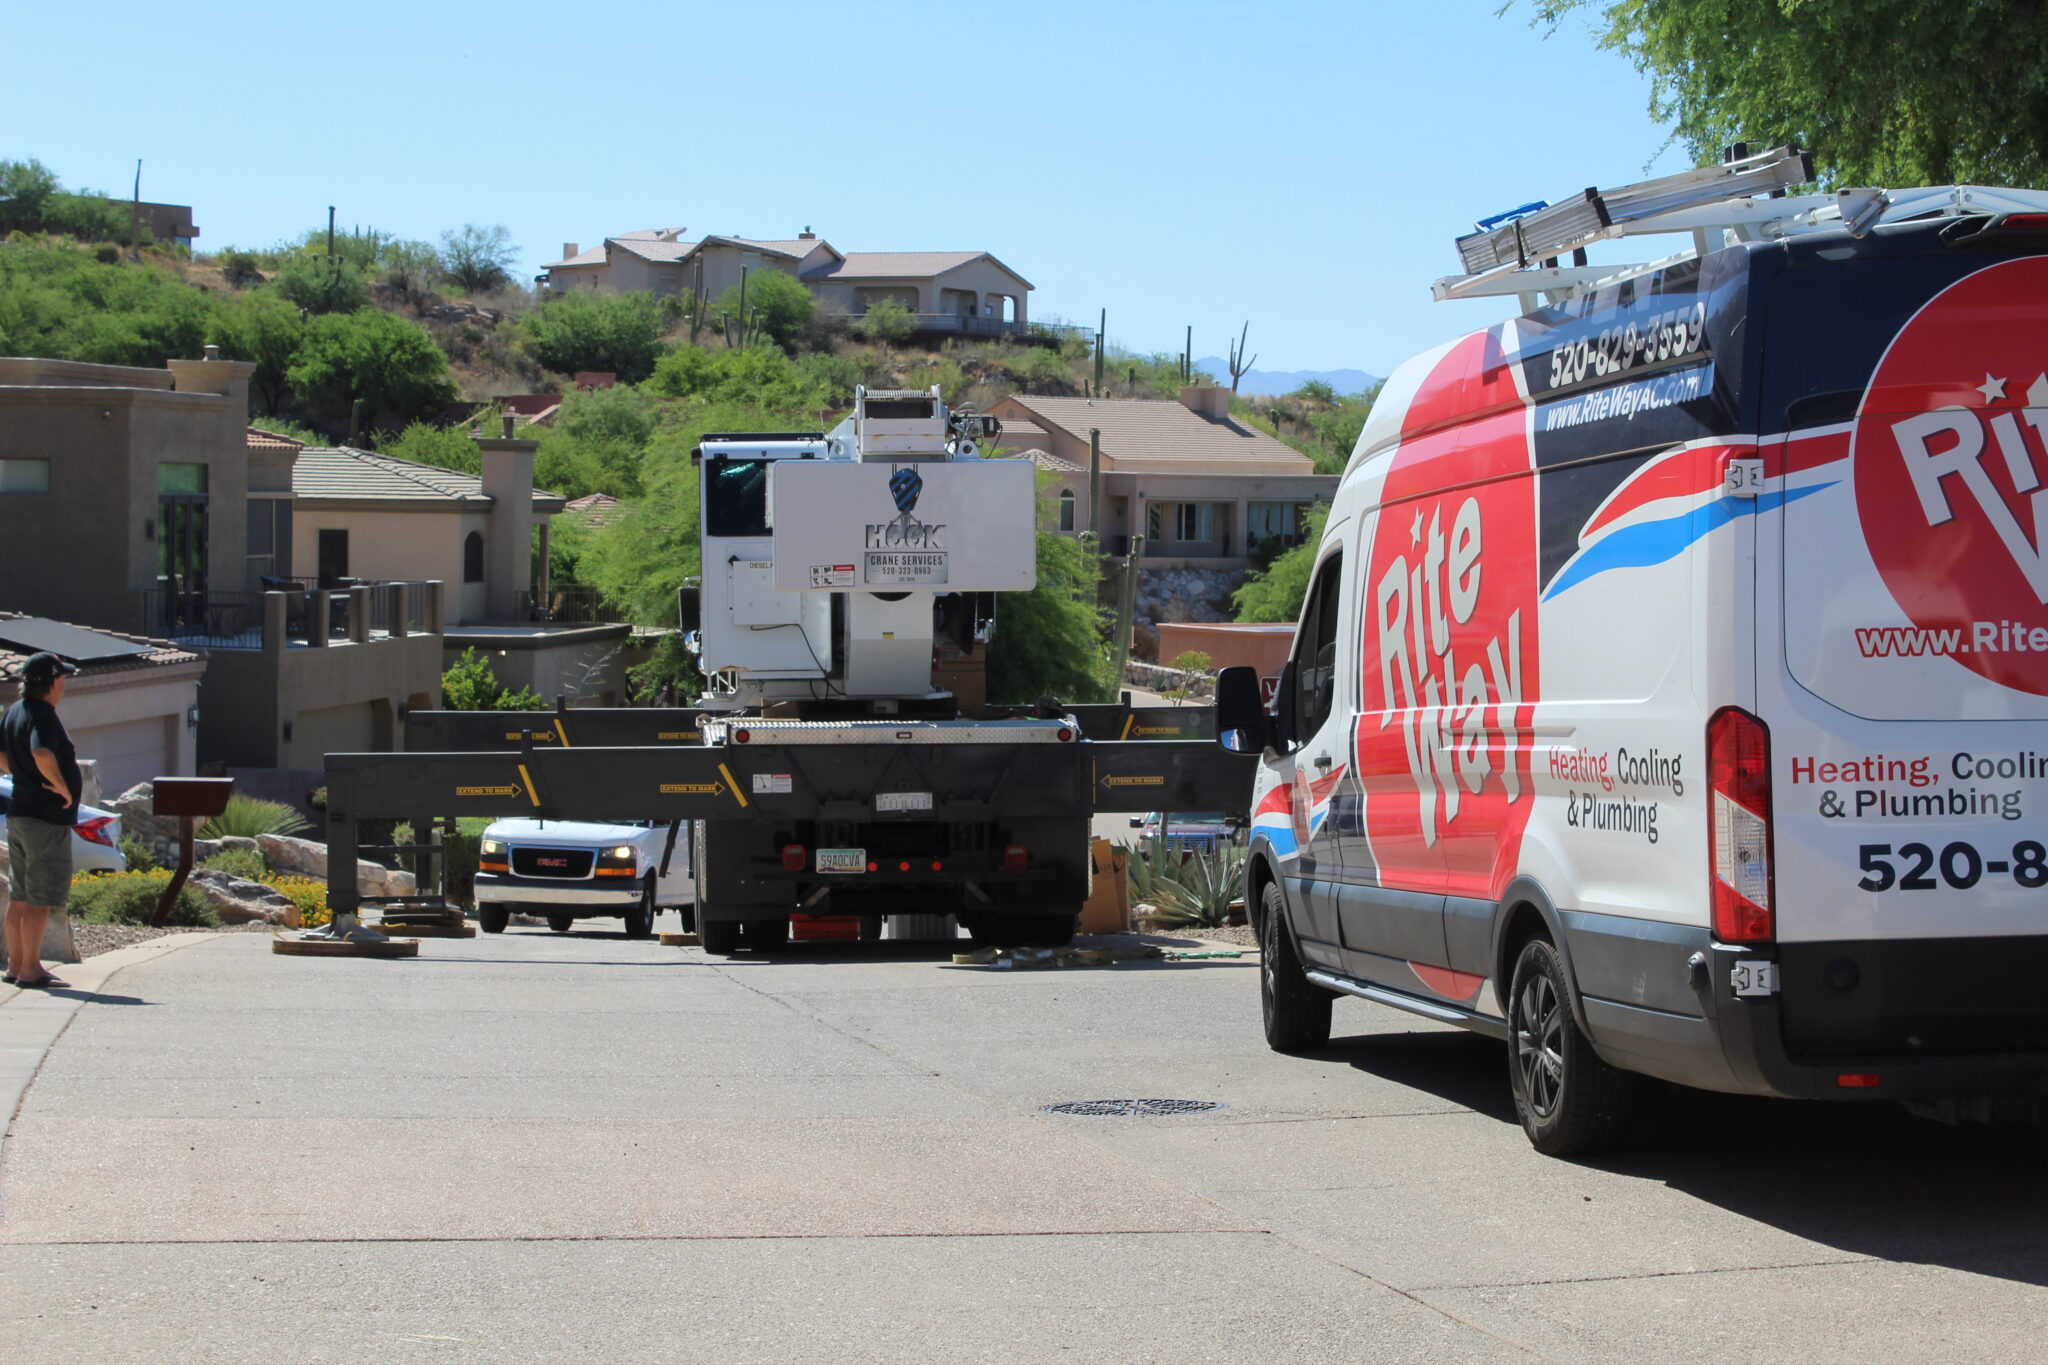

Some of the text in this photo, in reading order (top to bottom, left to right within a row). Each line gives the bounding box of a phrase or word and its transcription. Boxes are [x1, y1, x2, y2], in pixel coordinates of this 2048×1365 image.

[1549, 301, 1705, 389] 520-829-3559
[1546, 374, 1700, 432] www.RiteWayAC.com
[865, 524, 947, 549] HOOK
[870, 555, 943, 566] CRANE SERVICES
[1377, 496, 1483, 731] Rite
[1548, 745, 1684, 797] Heating, Cooling
[1791, 754, 1939, 787] Heating,
[1566, 789, 1659, 844] & Plumbing
[1818, 788, 2022, 821] & Plumbing
[1857, 840, 2048, 893] 520-8
